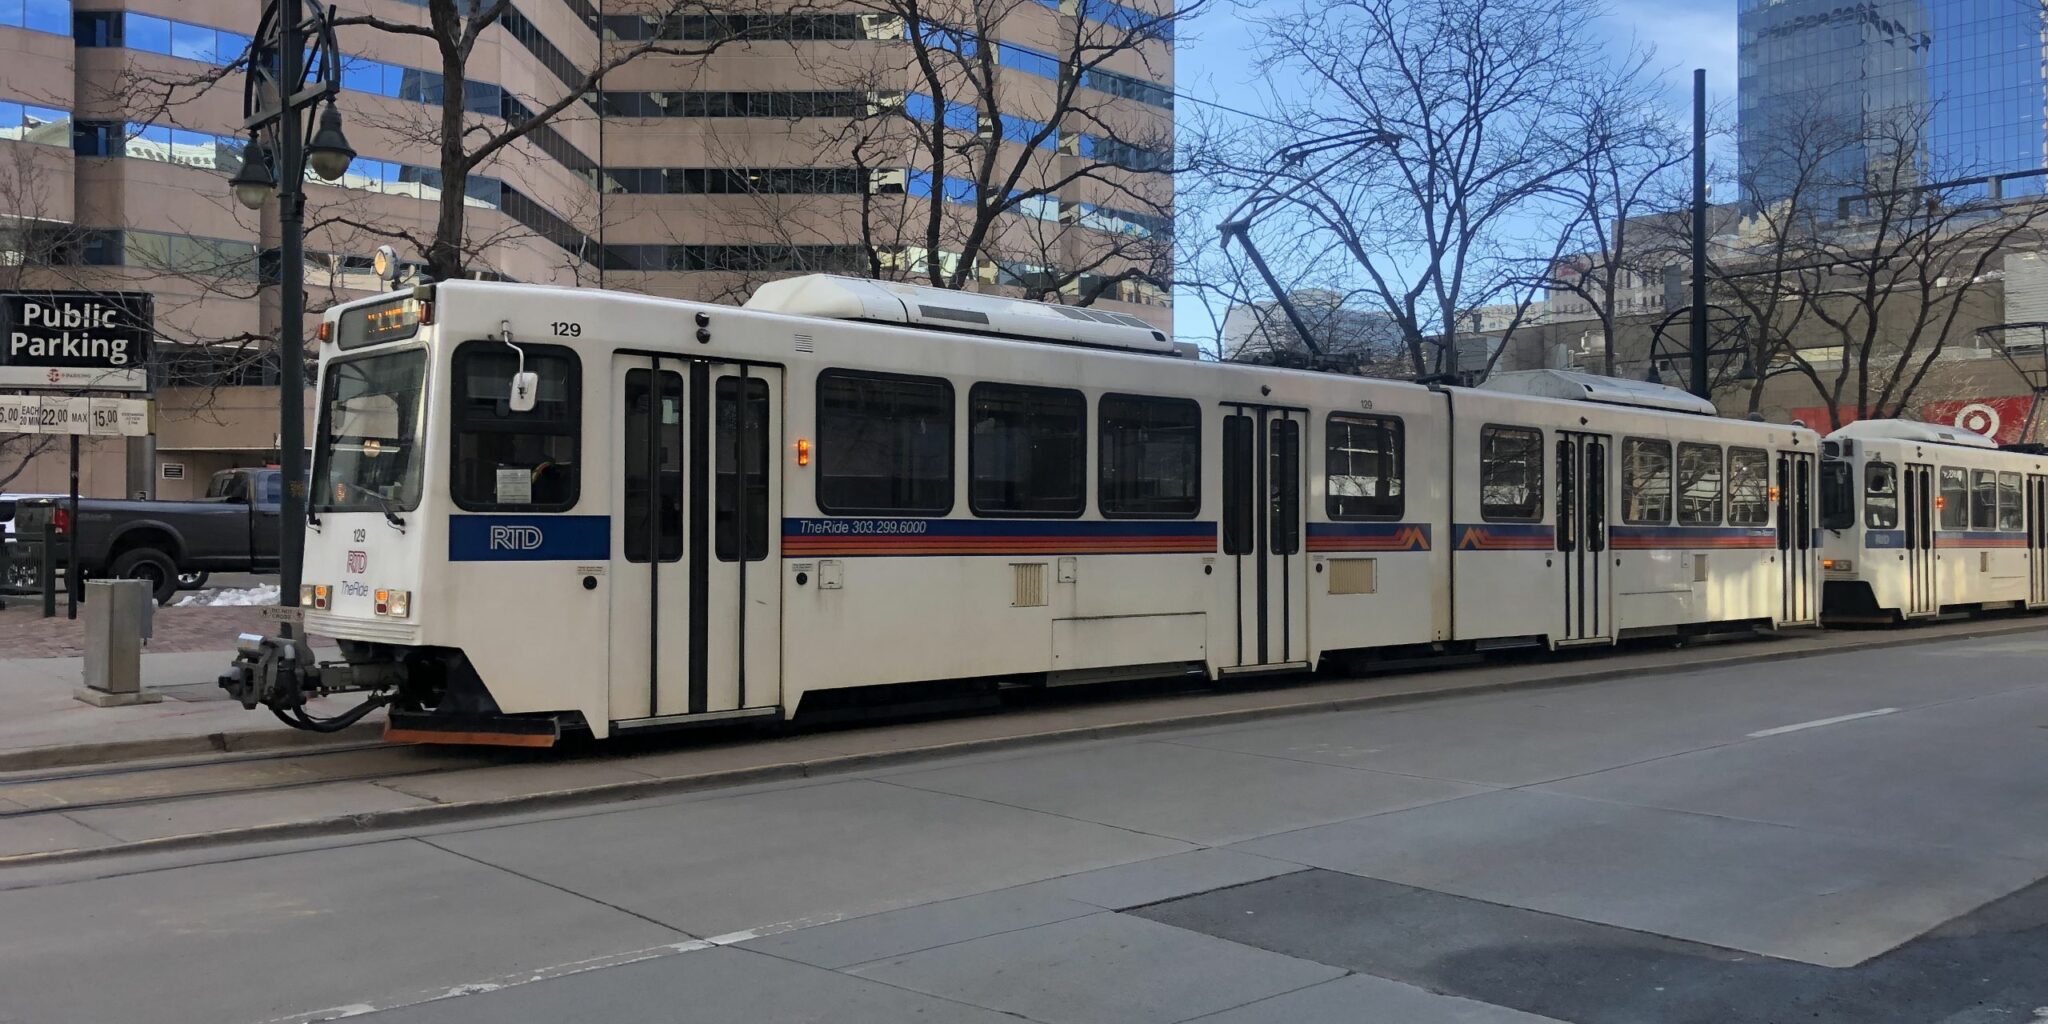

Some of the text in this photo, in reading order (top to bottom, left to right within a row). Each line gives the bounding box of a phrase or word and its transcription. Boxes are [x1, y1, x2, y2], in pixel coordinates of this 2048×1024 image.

[23, 302, 117, 329] Public
[550, 321, 582, 338] 129
[10, 331, 129, 365] Parking
[21, 405, 40, 416] EACH
[1360, 399, 1373, 410] 129
[41, 408, 68, 426] 22.00
[71, 412, 88, 423] MAX
[93, 409, 118, 427] 15.00
[353, 528, 366, 543] 129
[800, 520, 927, 534] TheRide 303.299.6000
[490, 525, 543, 550] RTD
[346, 550, 368, 574] RTD
[341, 580, 369, 597] TheRide
